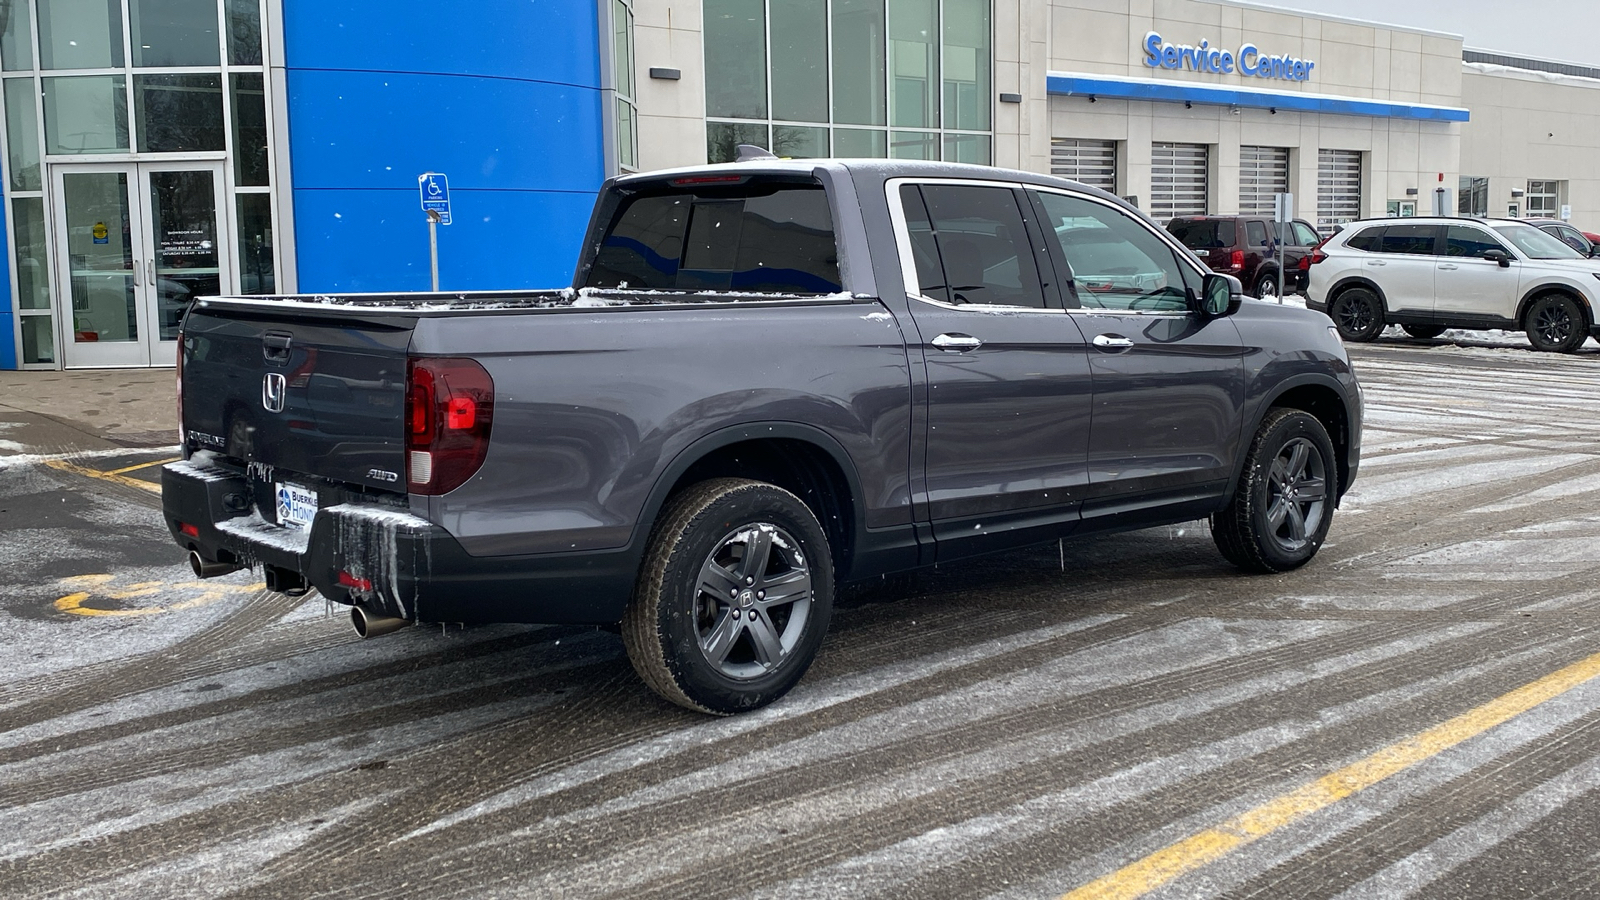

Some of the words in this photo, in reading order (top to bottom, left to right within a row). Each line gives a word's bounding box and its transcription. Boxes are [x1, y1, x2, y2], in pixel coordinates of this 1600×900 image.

[1142, 30, 1234, 74] Service
[1236, 43, 1315, 82] Center
[365, 468, 398, 482] AWD
[292, 491, 318, 507] BUERKLE
[292, 502, 316, 522] HOND
